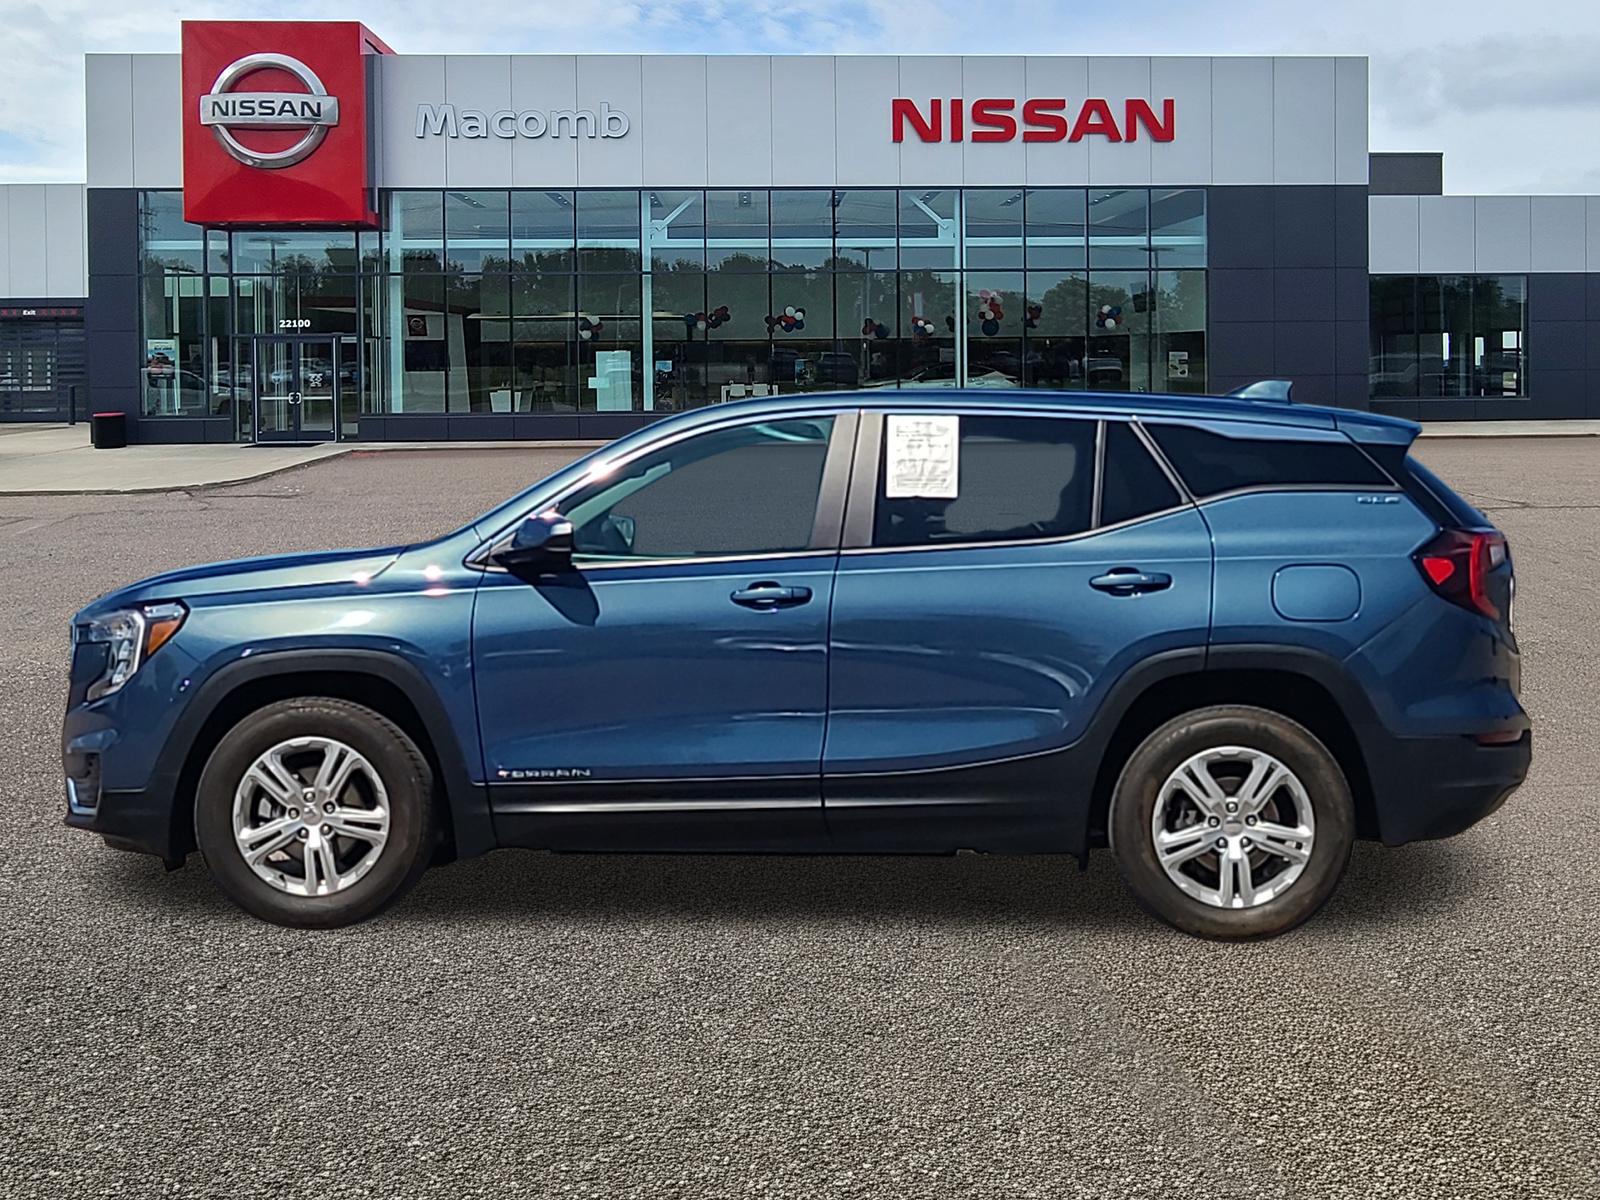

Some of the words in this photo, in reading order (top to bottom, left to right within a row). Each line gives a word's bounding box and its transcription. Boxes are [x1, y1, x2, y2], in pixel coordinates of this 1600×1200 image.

[212, 99, 322, 118] NISSAN
[415, 102, 630, 139] Macomb
[891, 98, 1175, 143] NISSAN
[279, 319, 311, 328] 22100
